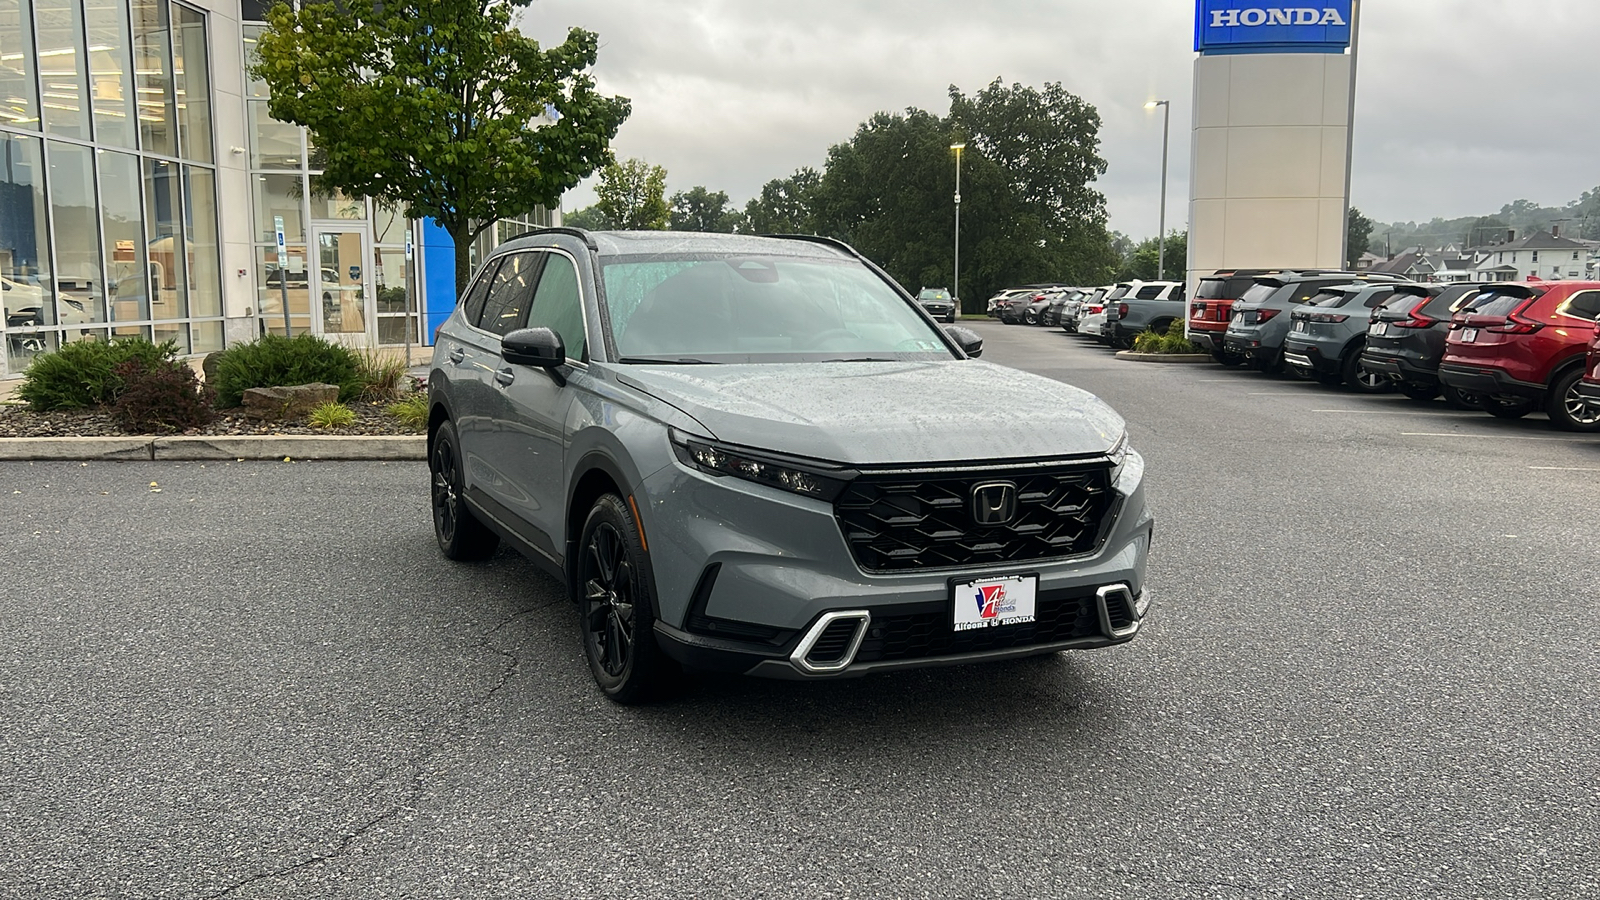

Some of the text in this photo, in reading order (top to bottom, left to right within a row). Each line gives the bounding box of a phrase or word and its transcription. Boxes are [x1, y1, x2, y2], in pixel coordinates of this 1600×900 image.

[1210, 8, 1346, 27] HONDA
[954, 622, 988, 632] Altoona
[1002, 615, 1036, 625] HONDA
